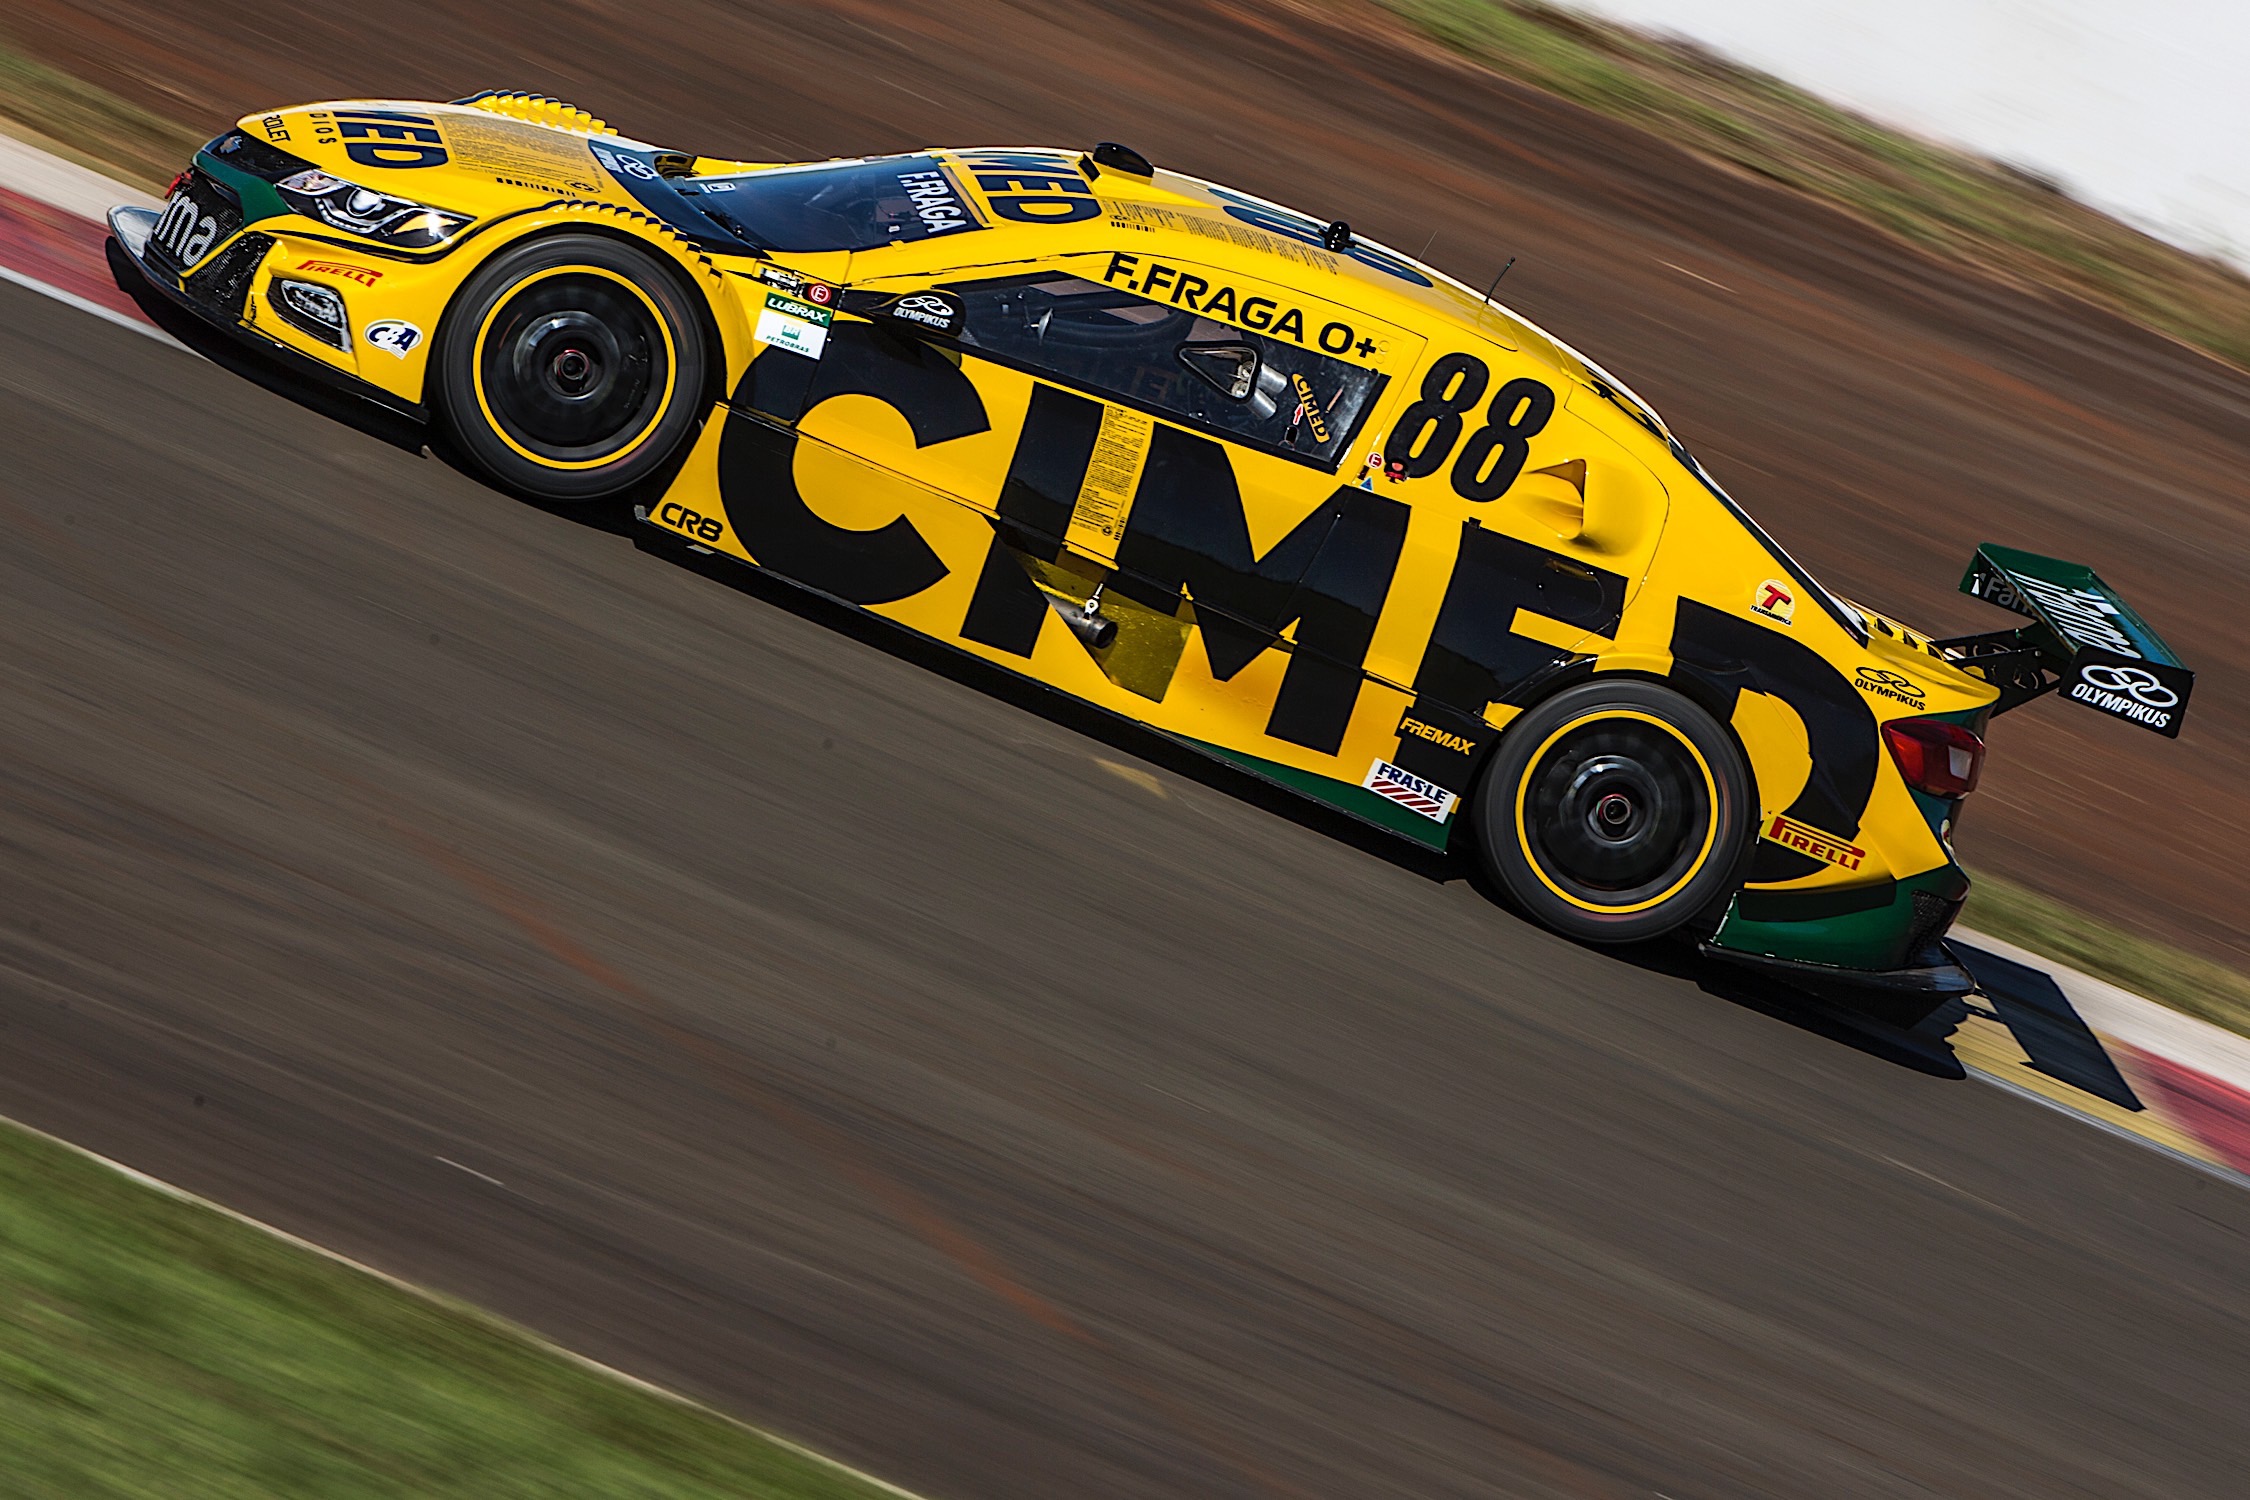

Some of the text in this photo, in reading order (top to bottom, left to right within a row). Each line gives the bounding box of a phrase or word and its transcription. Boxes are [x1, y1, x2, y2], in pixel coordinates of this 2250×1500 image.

[896, 170, 967, 234] F.FRAGA
[296, 259, 383, 288] PIRELLI
[767, 297, 828, 323] LUBRAX
[892, 306, 951, 329] OLYMPIKUS
[1103, 251, 1304, 344] F.FRAGA
[766, 335, 810, 353] PETROBRAS
[1296, 376, 1328, 438] CIMED
[1383, 351, 1556, 503] 88
[660, 502, 724, 543] CR8
[717, 320, 1881, 884] CIMED
[1854, 677, 1927, 711] OLYMPIKUS
[2070, 682, 2172, 729] OLYMPIKUS
[1399, 716, 1477, 756] FREMAX
[1768, 815, 1867, 872] PIRELLI
